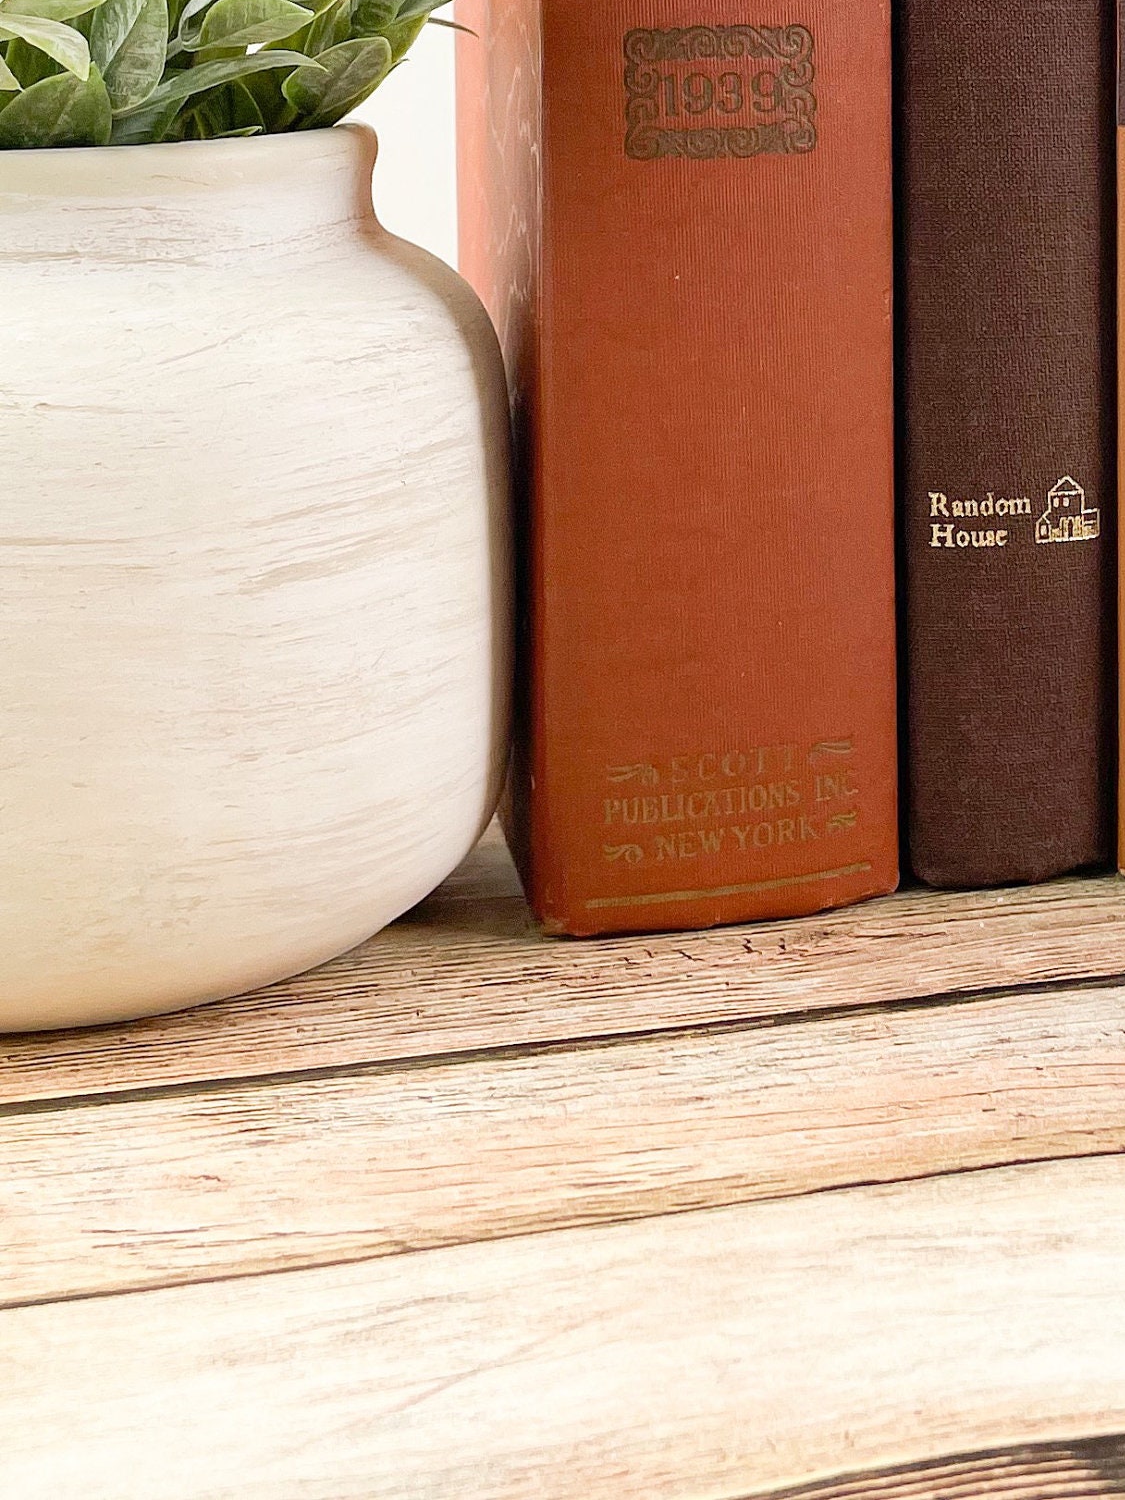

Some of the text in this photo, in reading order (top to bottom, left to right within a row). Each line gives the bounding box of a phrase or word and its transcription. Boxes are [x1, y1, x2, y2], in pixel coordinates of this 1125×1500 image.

[659, 71, 781, 117] 1939
[928, 491, 1031, 518] Random
[929, 523, 1008, 548] House
[670, 745, 794, 784] SCOTT
[603, 779, 801, 825] PUBLICATIONS
[655, 814, 822, 862] NEW YORK
